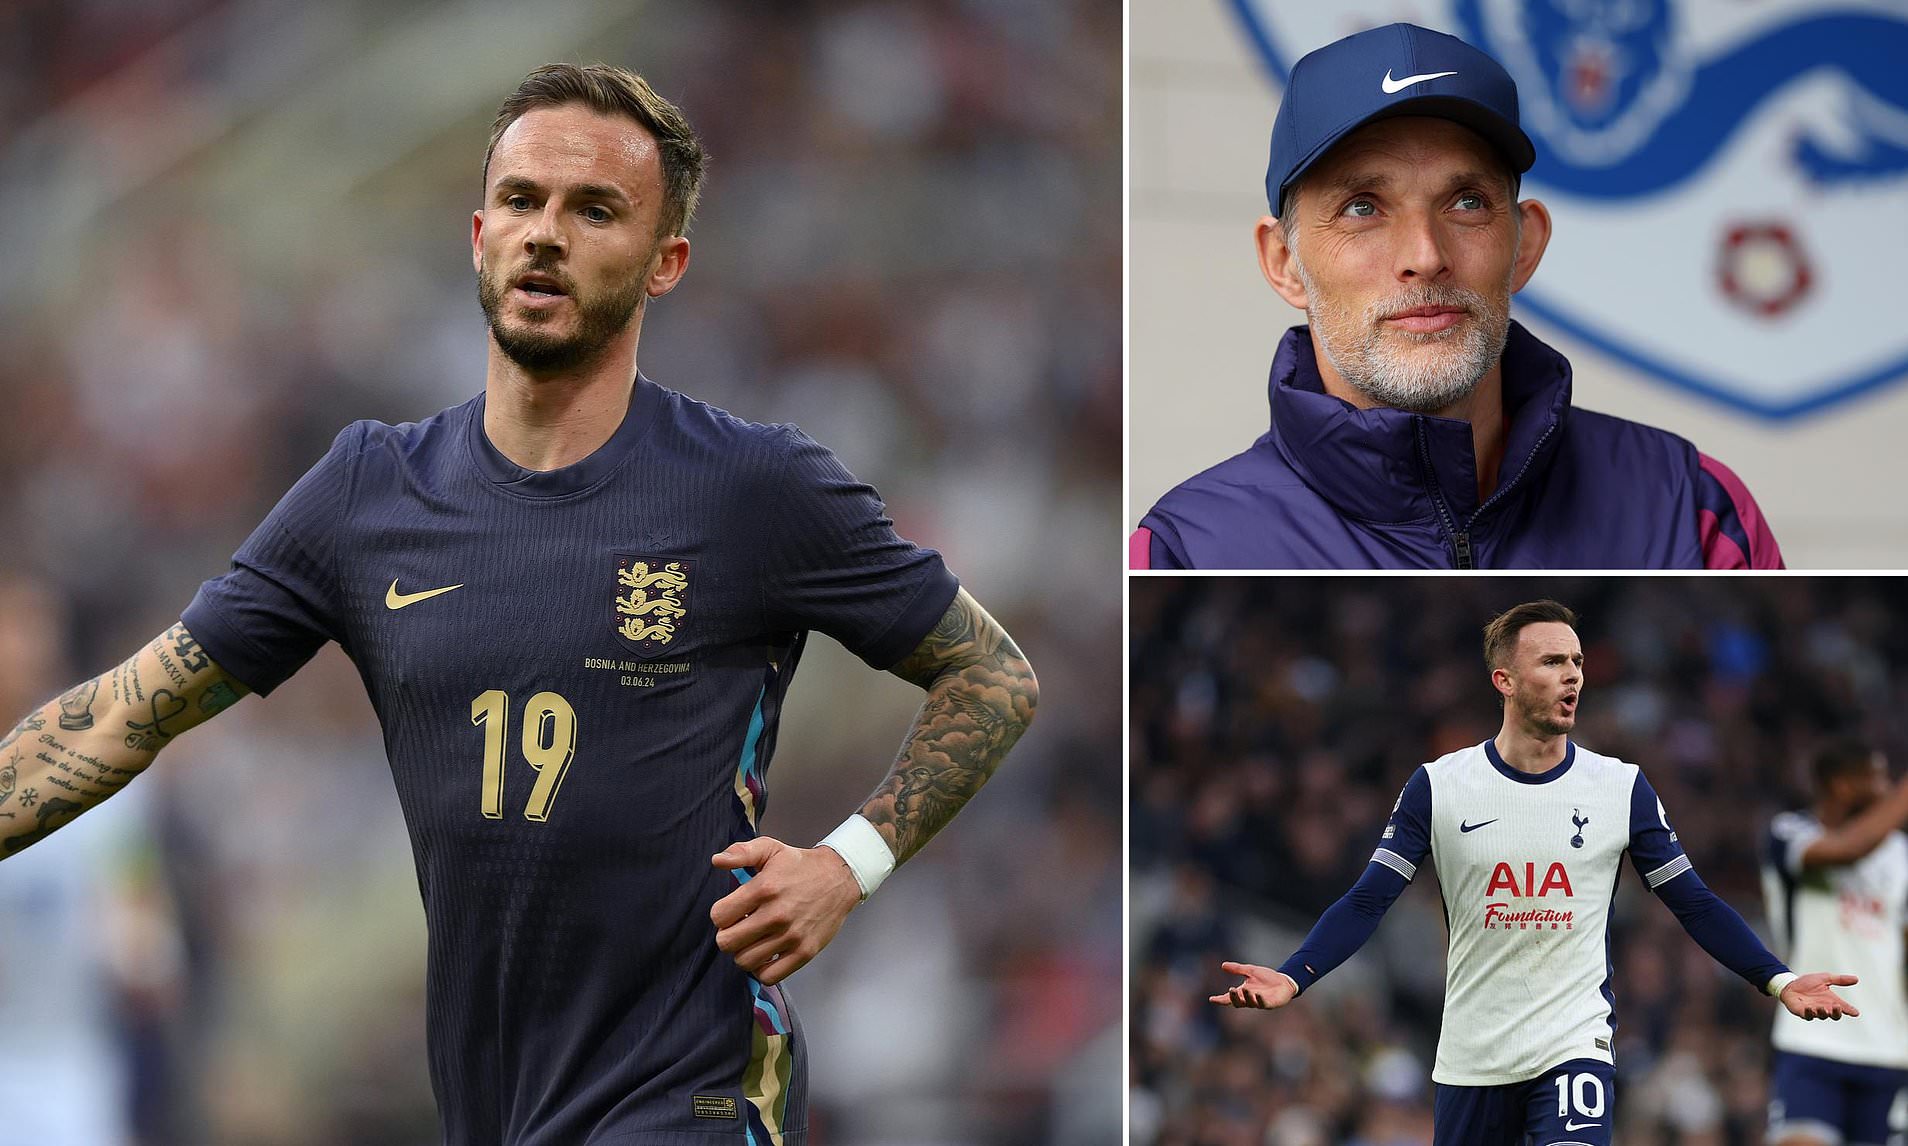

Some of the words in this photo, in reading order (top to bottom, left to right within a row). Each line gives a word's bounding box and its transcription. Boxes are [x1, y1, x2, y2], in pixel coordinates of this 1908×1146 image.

[584, 658, 616, 670] BOSNIA
[618, 661, 637, 672] AND
[637, 662, 690, 674] HERZEGOVINA
[620, 675, 655, 687] 03.06.24
[38, 733, 67, 752] There
[77, 752, 112, 774] nothing
[471, 689, 577, 822] 19
[58, 761, 73, 773] the
[73, 767, 94, 782] love
[1485, 861, 1574, 898] AIA
[1484, 903, 1574, 929] Foundation
[1555, 1072, 1605, 1119] 10
